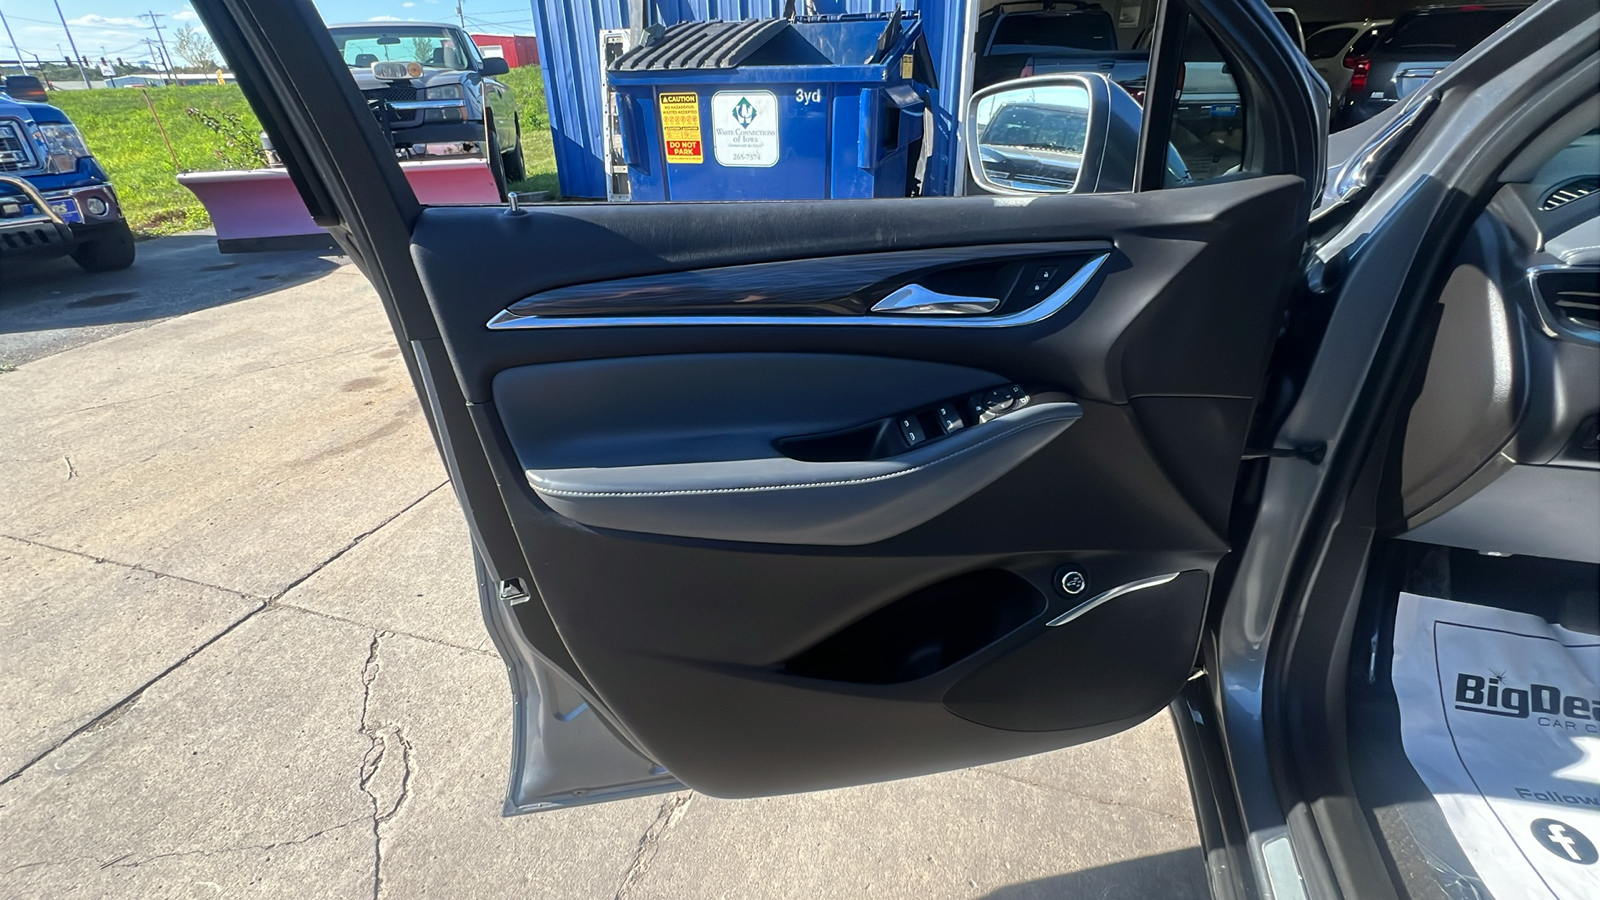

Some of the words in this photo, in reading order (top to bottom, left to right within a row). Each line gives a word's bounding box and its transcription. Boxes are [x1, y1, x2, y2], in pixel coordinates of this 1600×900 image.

[667, 95, 695, 103] CAUTION
[796, 88, 821, 106] 3yd
[733, 135, 741, 143] of
[674, 148, 694, 156] PARK
[1455, 672, 1600, 722] BigDe
[1538, 717, 1577, 731] CAR
[1514, 787, 1600, 806] Follow
